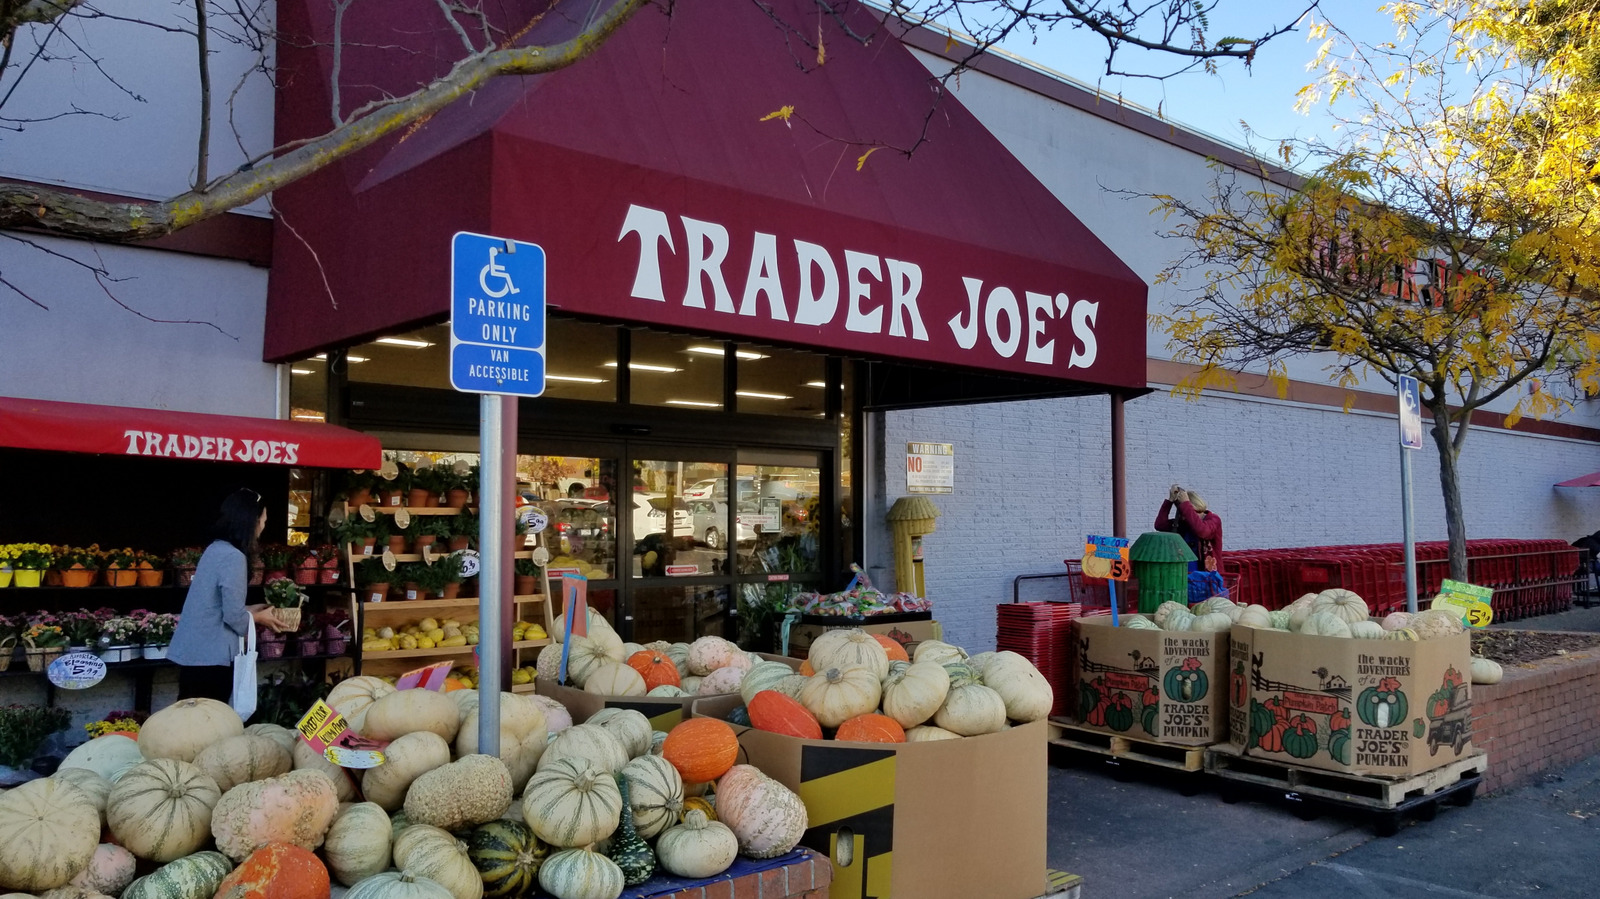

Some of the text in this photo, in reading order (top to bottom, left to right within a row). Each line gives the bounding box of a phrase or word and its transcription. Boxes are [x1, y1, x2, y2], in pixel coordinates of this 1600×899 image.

[617, 204, 1099, 369] TRADER JOE'S
[469, 298, 530, 322] PARKING
[482, 324, 517, 343] ONLY
[490, 349, 509, 363] VAN
[469, 364, 529, 382] ACCESSIBLE
[123, 430, 300, 465] TRADER JOE'S
[912, 444, 948, 455] WARNING
[908, 456, 923, 473] NO
[1163, 638, 1210, 648] the wacky
[1164, 647, 1210, 657] ADVENTURES
[1358, 654, 1411, 669] the wacky
[1357, 665, 1411, 676] ADVENTURES
[1358, 675, 1370, 686] of
[1164, 704, 1210, 714] TRADER
[1316, 701, 1336, 713] Patch
[1163, 726, 1210, 738] PUMPKIN
[1356, 729, 1409, 741] TRADER
[1356, 753, 1409, 767] PUMPKIN
